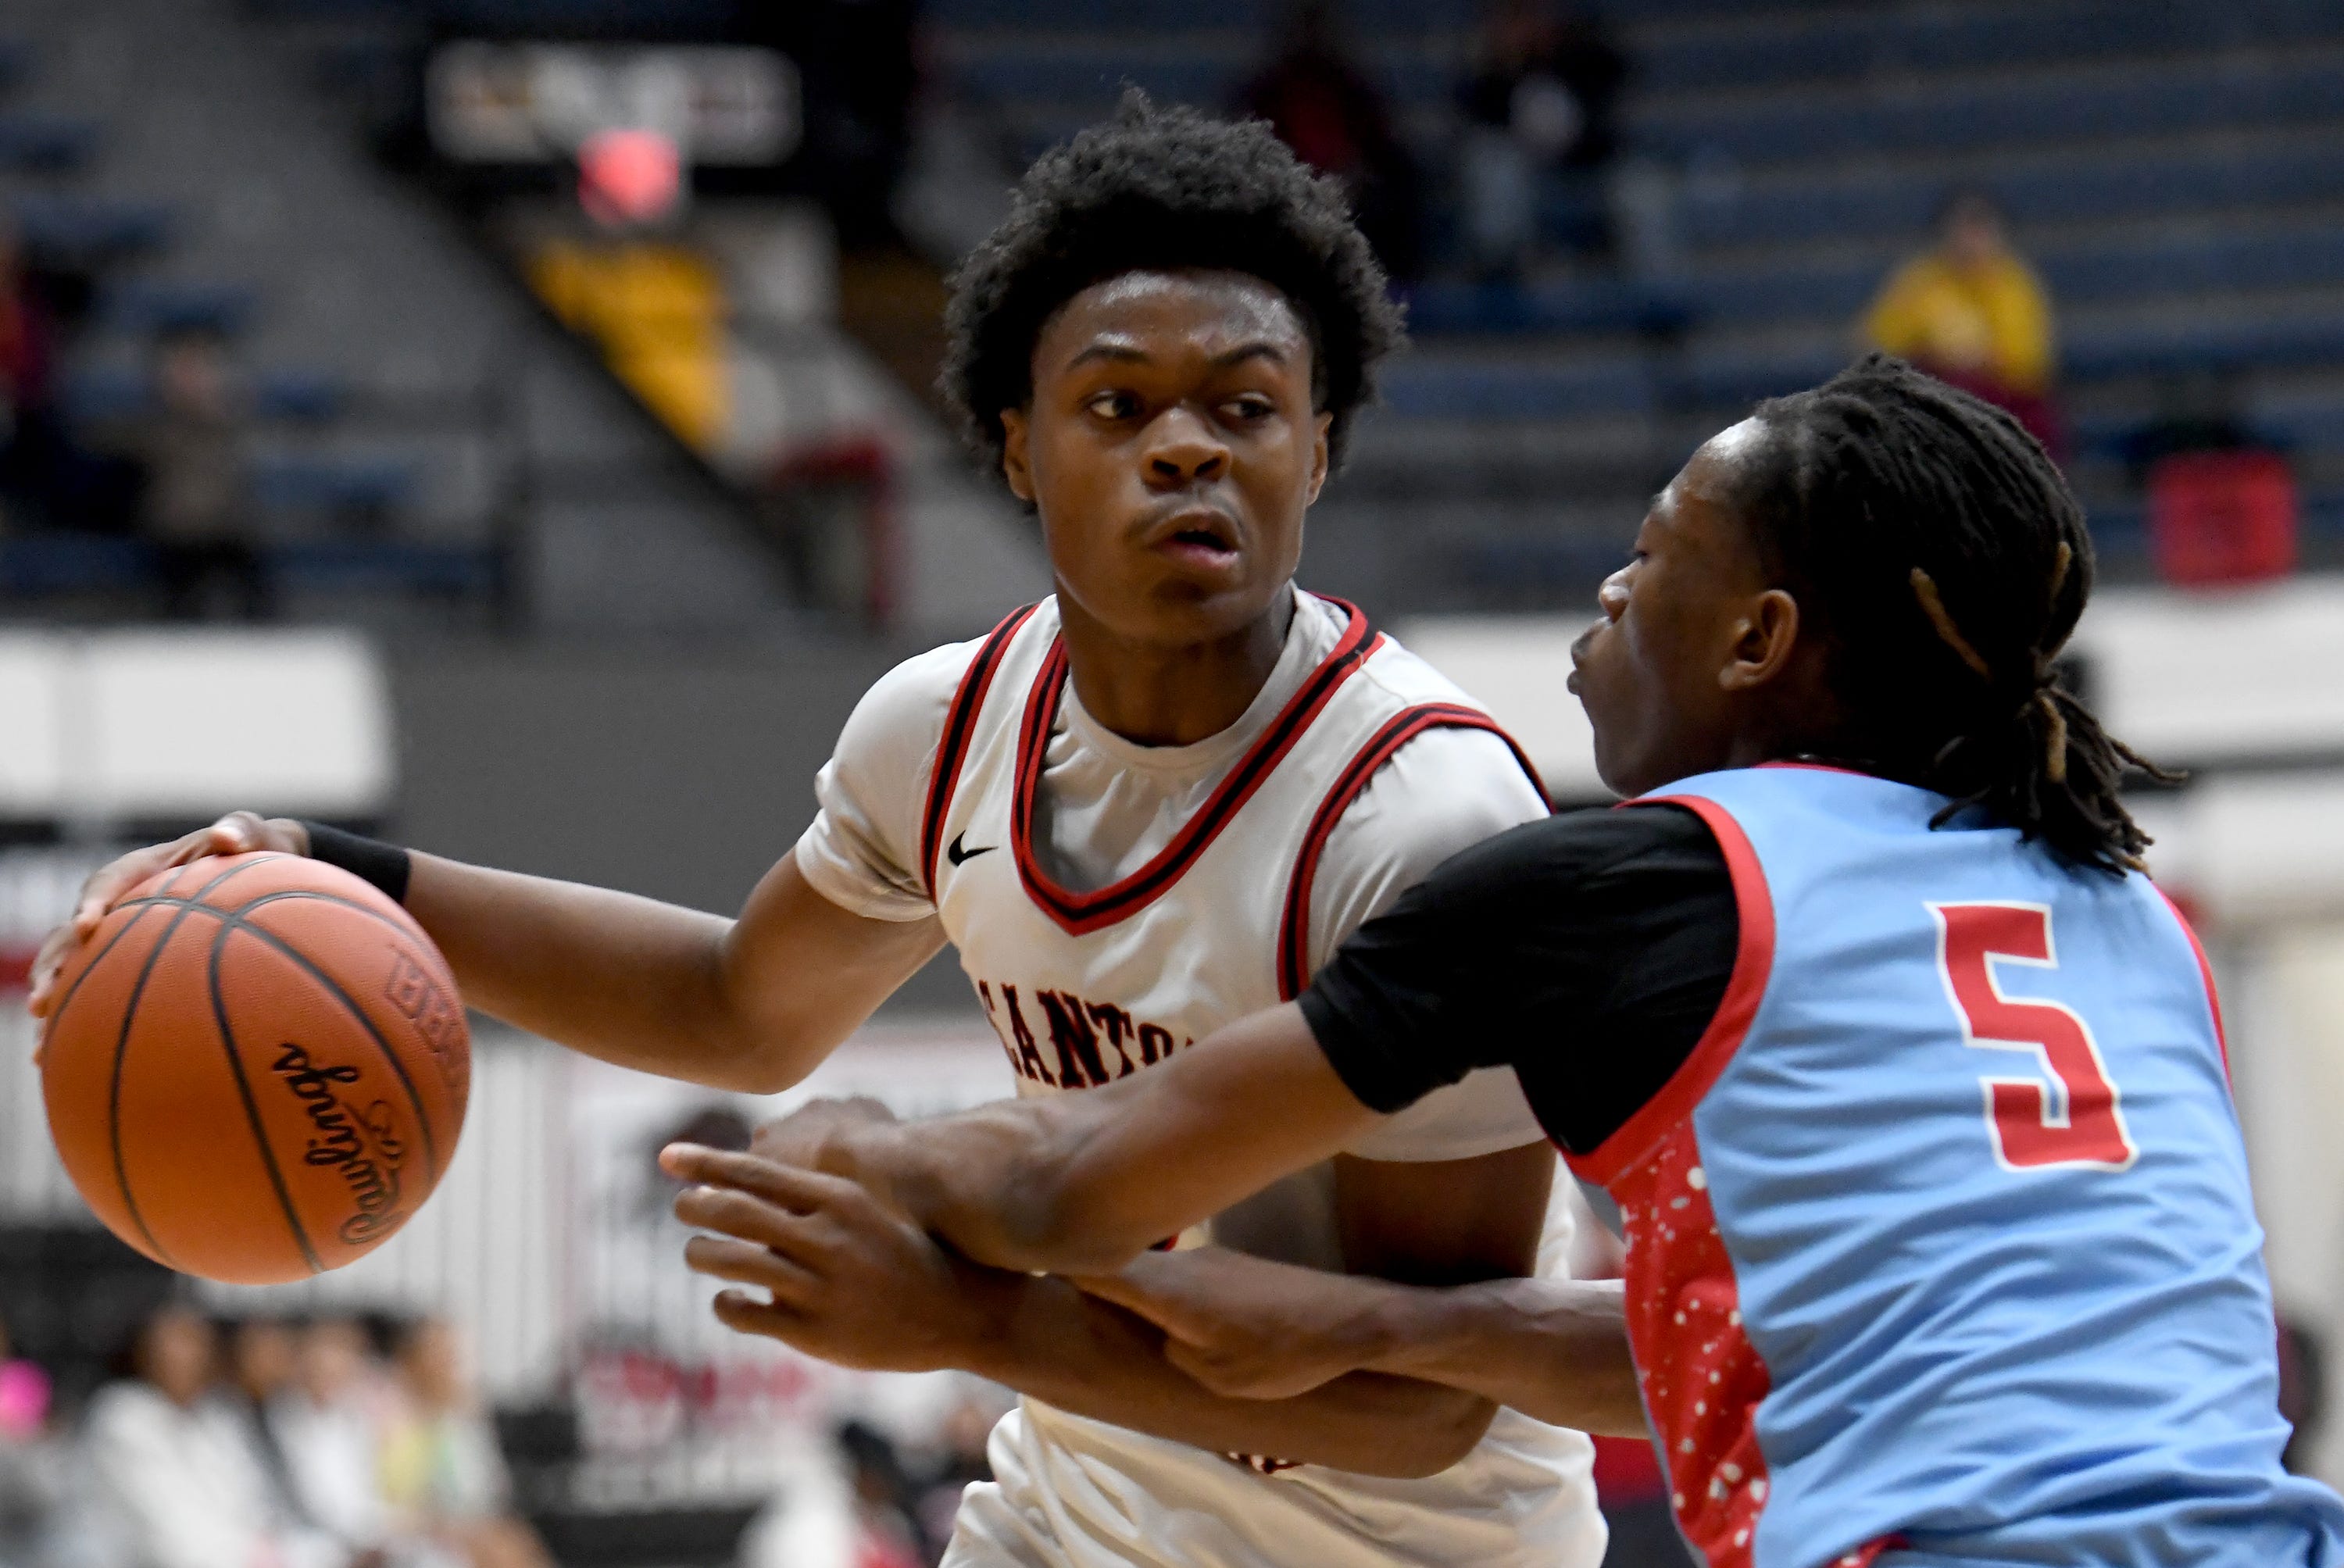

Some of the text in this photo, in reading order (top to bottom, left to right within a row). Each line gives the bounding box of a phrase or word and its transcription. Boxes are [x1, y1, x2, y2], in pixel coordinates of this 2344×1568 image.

[978, 979, 1194, 1089] ANTO
[1923, 900, 2139, 1172] 5
[271, 1041, 406, 1245] Rawlings
